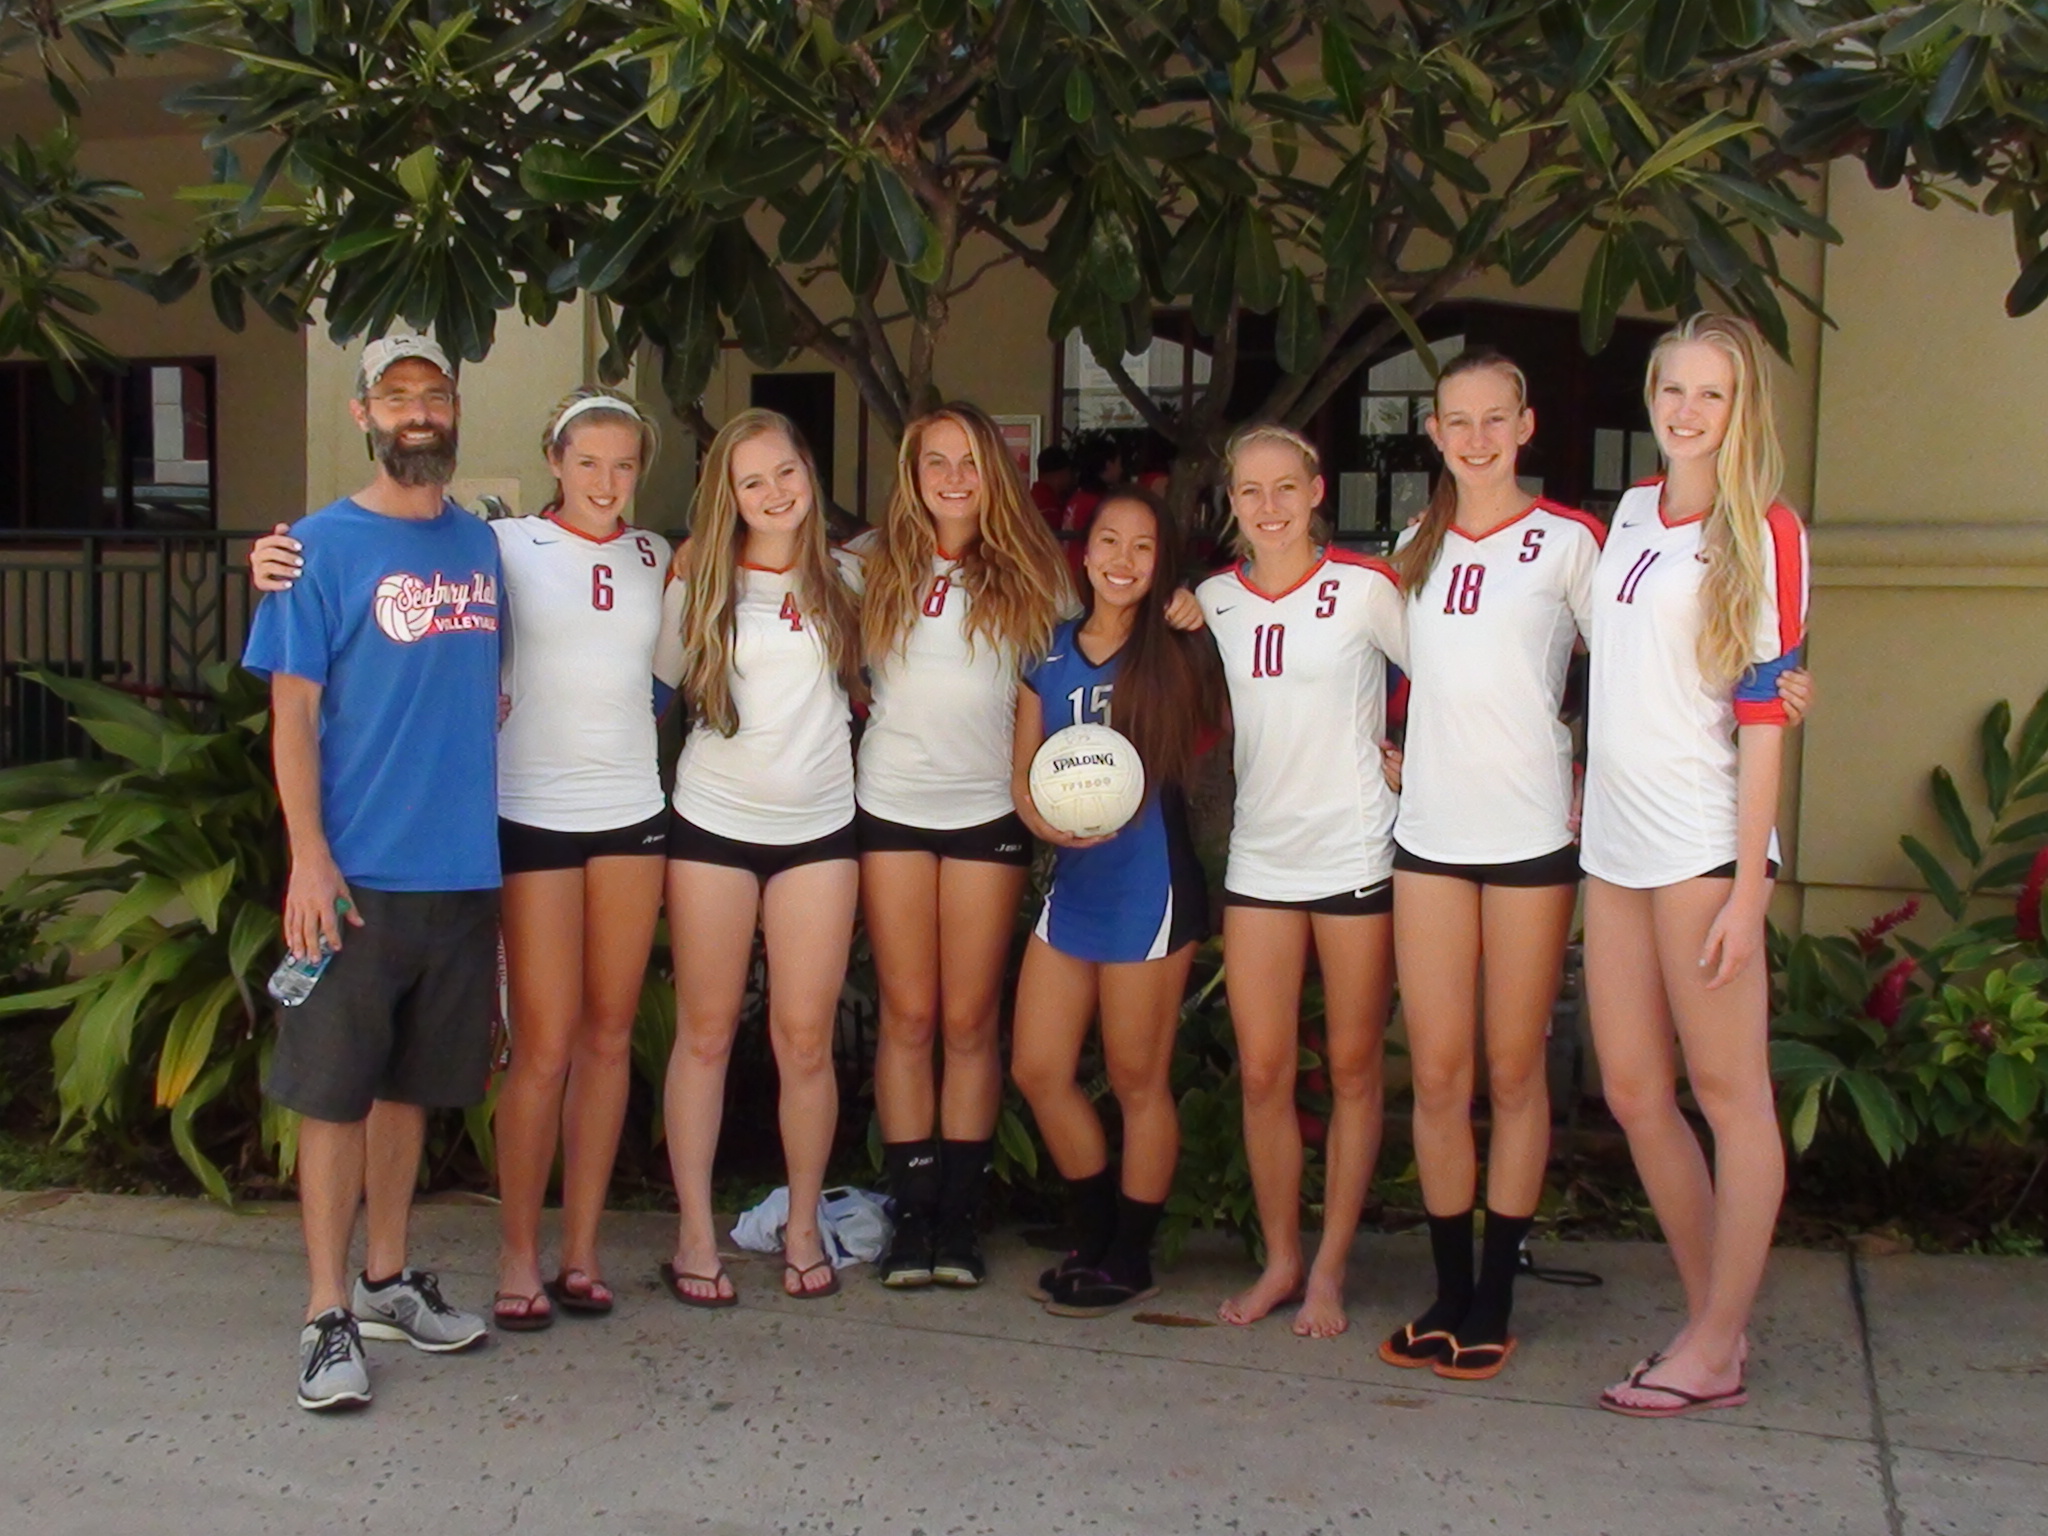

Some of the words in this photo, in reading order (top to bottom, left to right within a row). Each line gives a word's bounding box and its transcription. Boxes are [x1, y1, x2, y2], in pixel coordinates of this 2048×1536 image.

[635, 537, 656, 567] S
[1519, 529, 1546, 563] S
[396, 573, 470, 614] Seabury
[593, 564, 613, 611] 6
[922, 576, 951, 617] 8
[1444, 564, 1486, 615] 18
[1617, 549, 1661, 604] 11
[780, 592, 804, 632] 4
[1315, 580, 1339, 618] S
[1252, 624, 1285, 678] 10
[1067, 684, 1114, 726] 15
[1053, 752, 1116, 774] SPALDING
